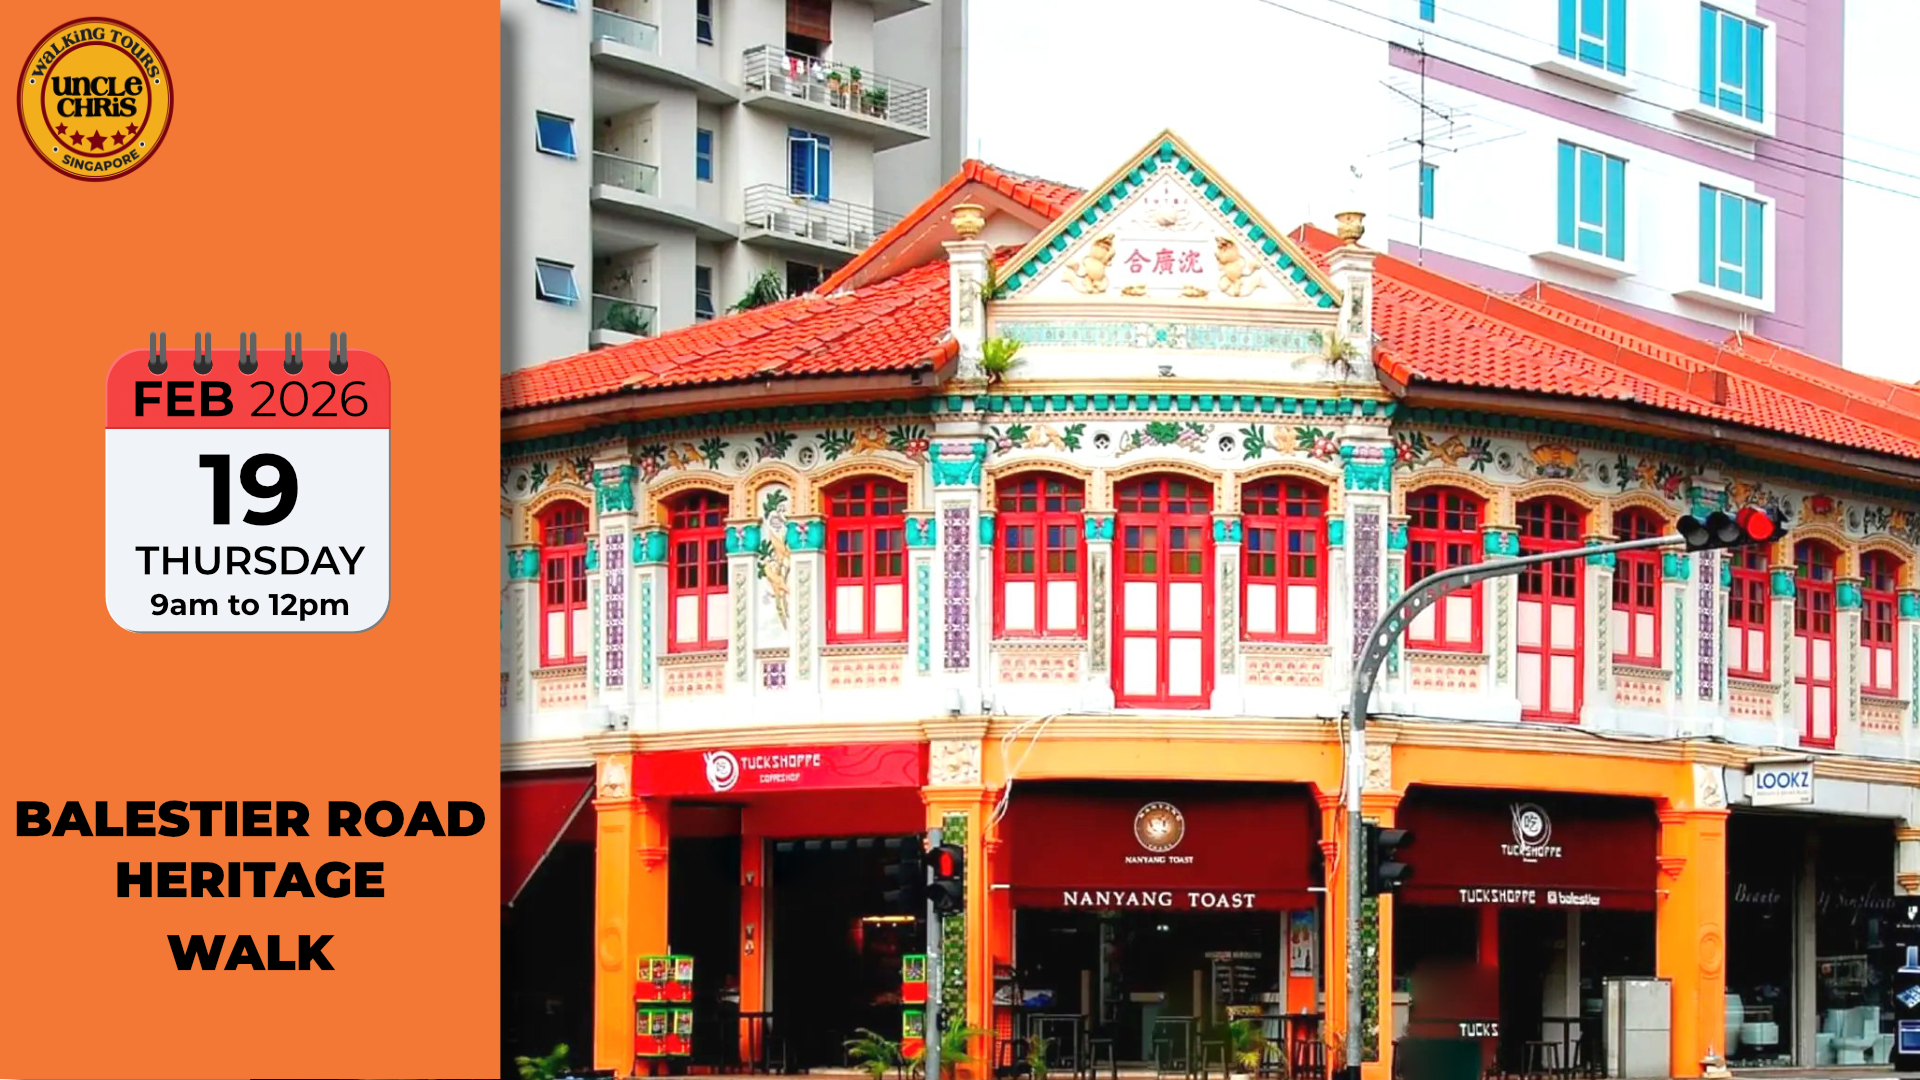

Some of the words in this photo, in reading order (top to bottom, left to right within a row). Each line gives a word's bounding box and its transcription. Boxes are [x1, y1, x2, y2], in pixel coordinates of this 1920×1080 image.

[740, 753, 821, 770] TUCKSHOPPE
[1756, 771, 1809, 789] LOOKZ
[1125, 856, 1166, 864] NANYANG
[1168, 856, 1194, 864] TOAST
[1063, 891, 1173, 907] NANYANG
[1187, 892, 1256, 908] TOAST
[1459, 889, 1536, 905] TUCKSHOPPE
[1459, 1023, 1499, 1037] TUCKS
